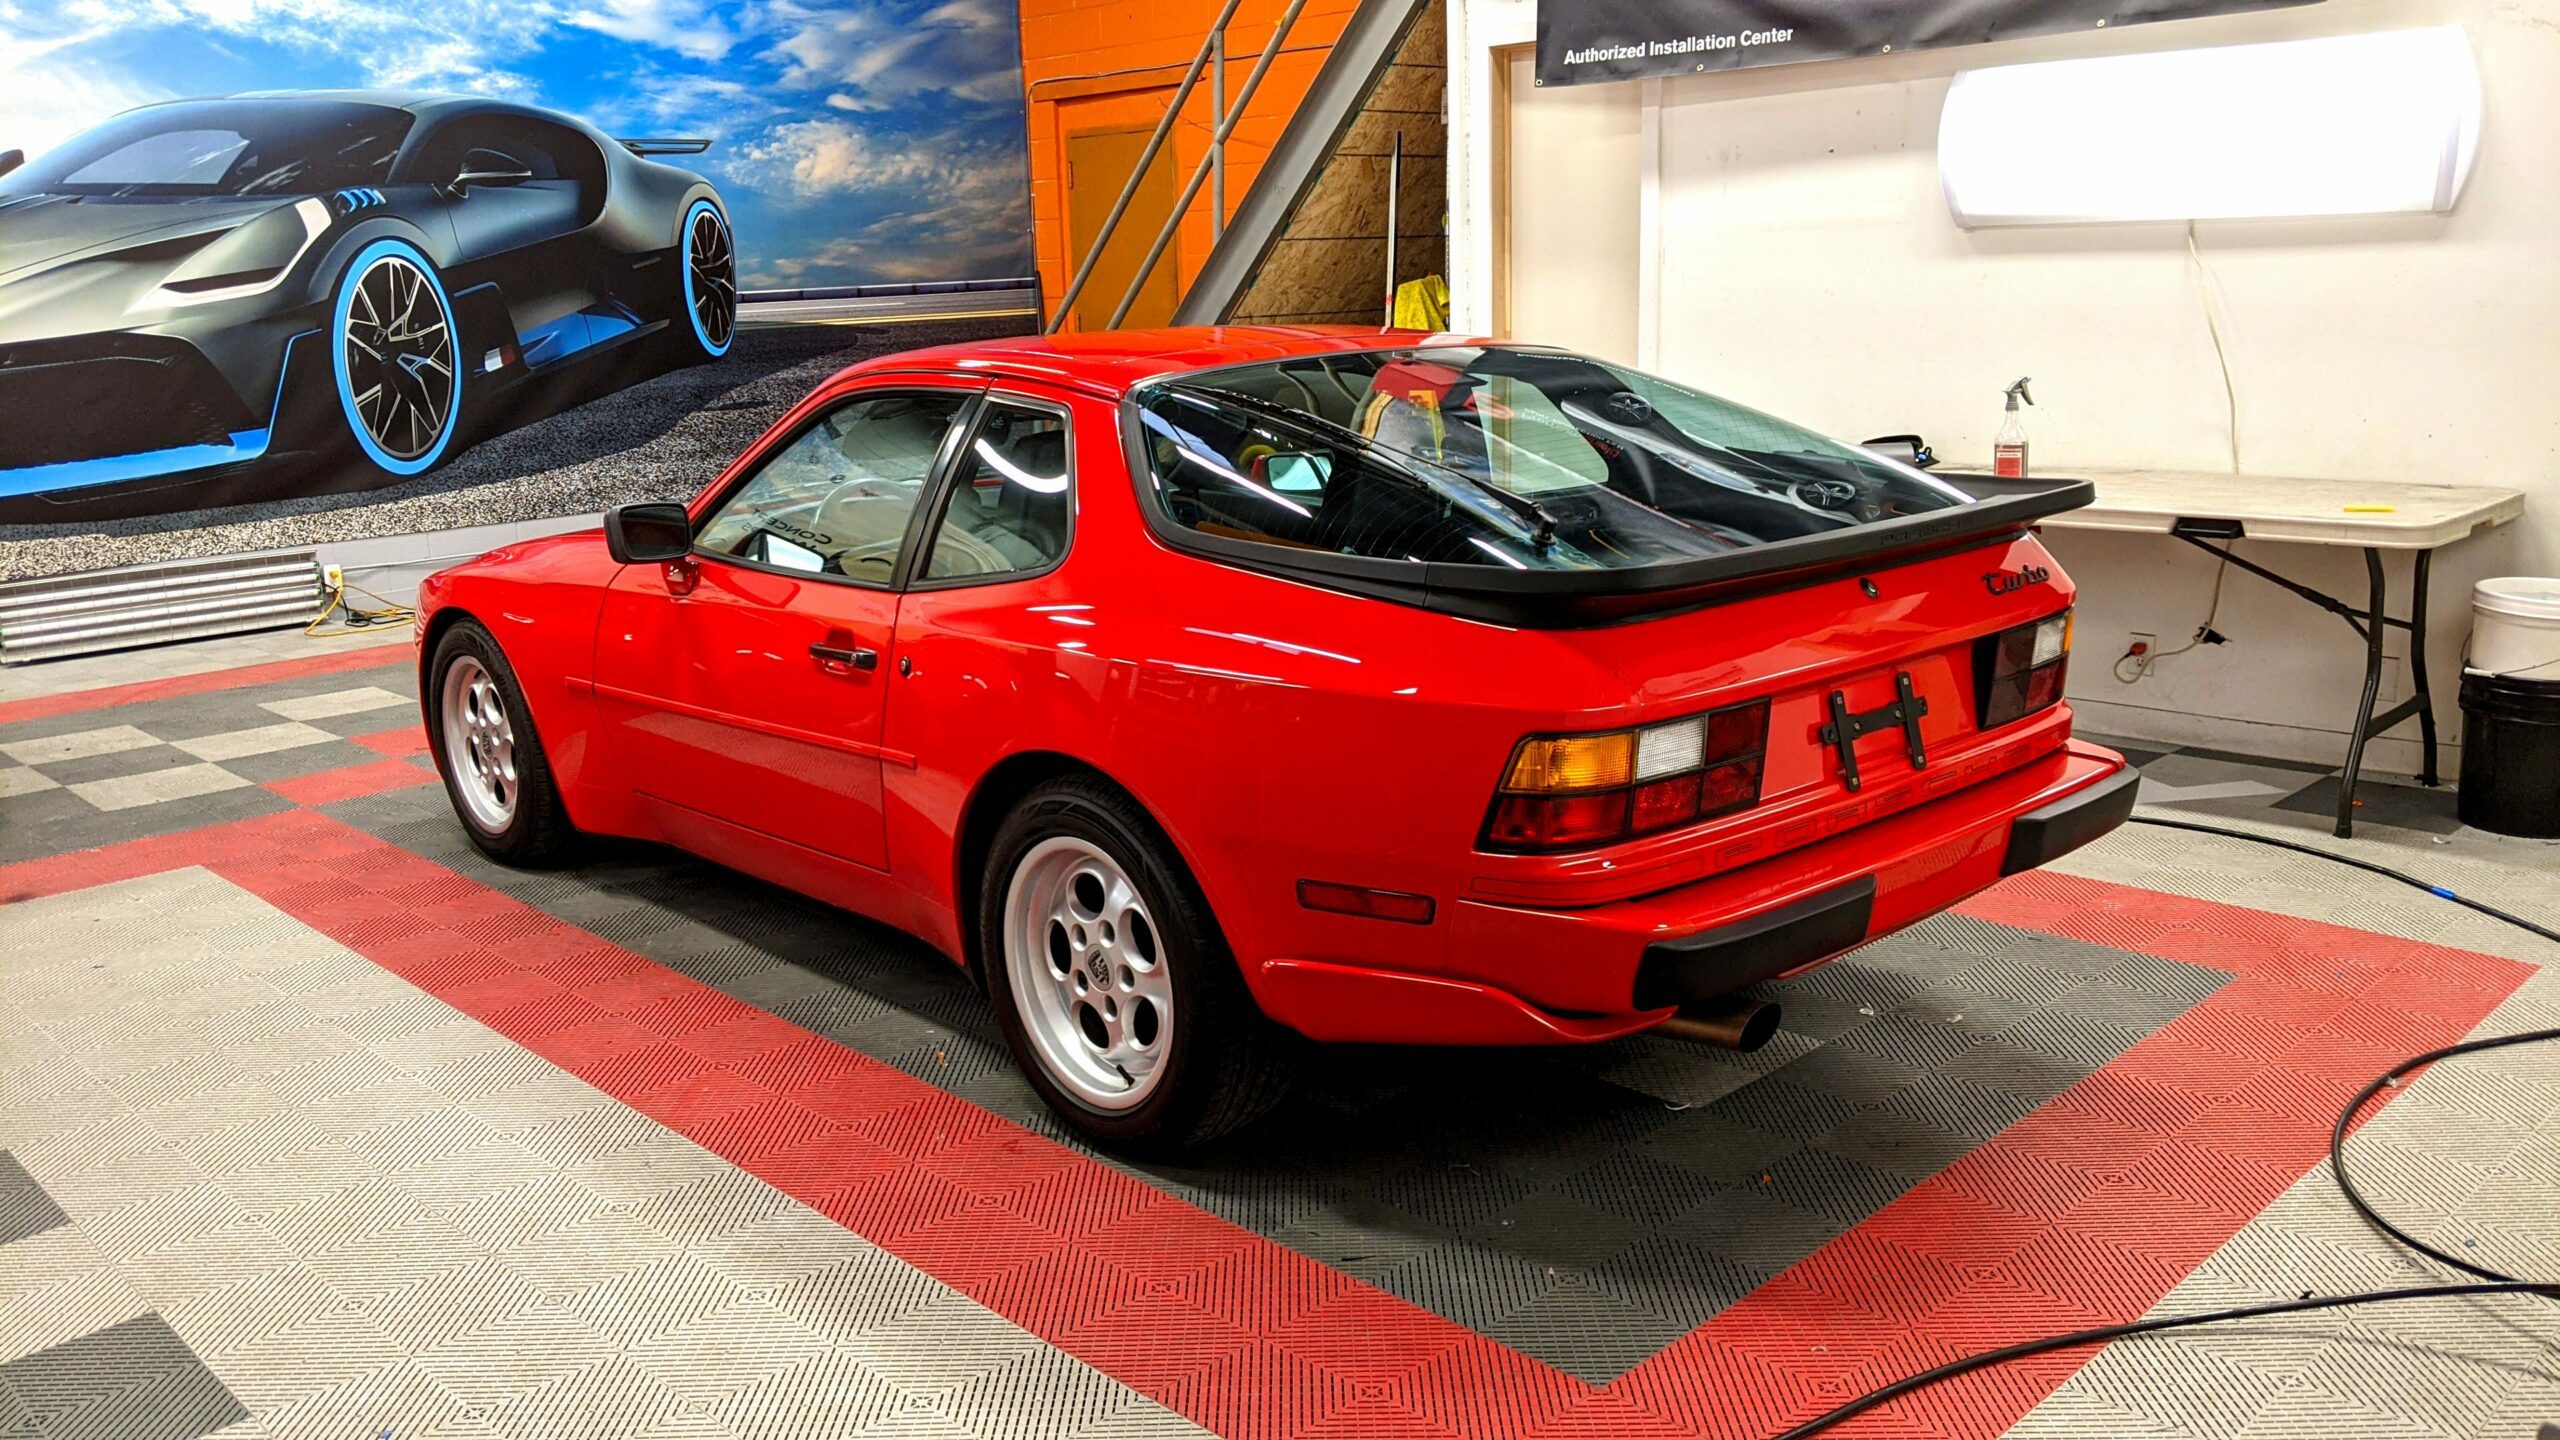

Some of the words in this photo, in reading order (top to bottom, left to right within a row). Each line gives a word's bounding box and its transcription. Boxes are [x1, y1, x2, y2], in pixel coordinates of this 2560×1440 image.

[1564, 44, 1646, 65] Authorized
[1649, 34, 1736, 57] Installation
[1740, 27, 1794, 47] Center
